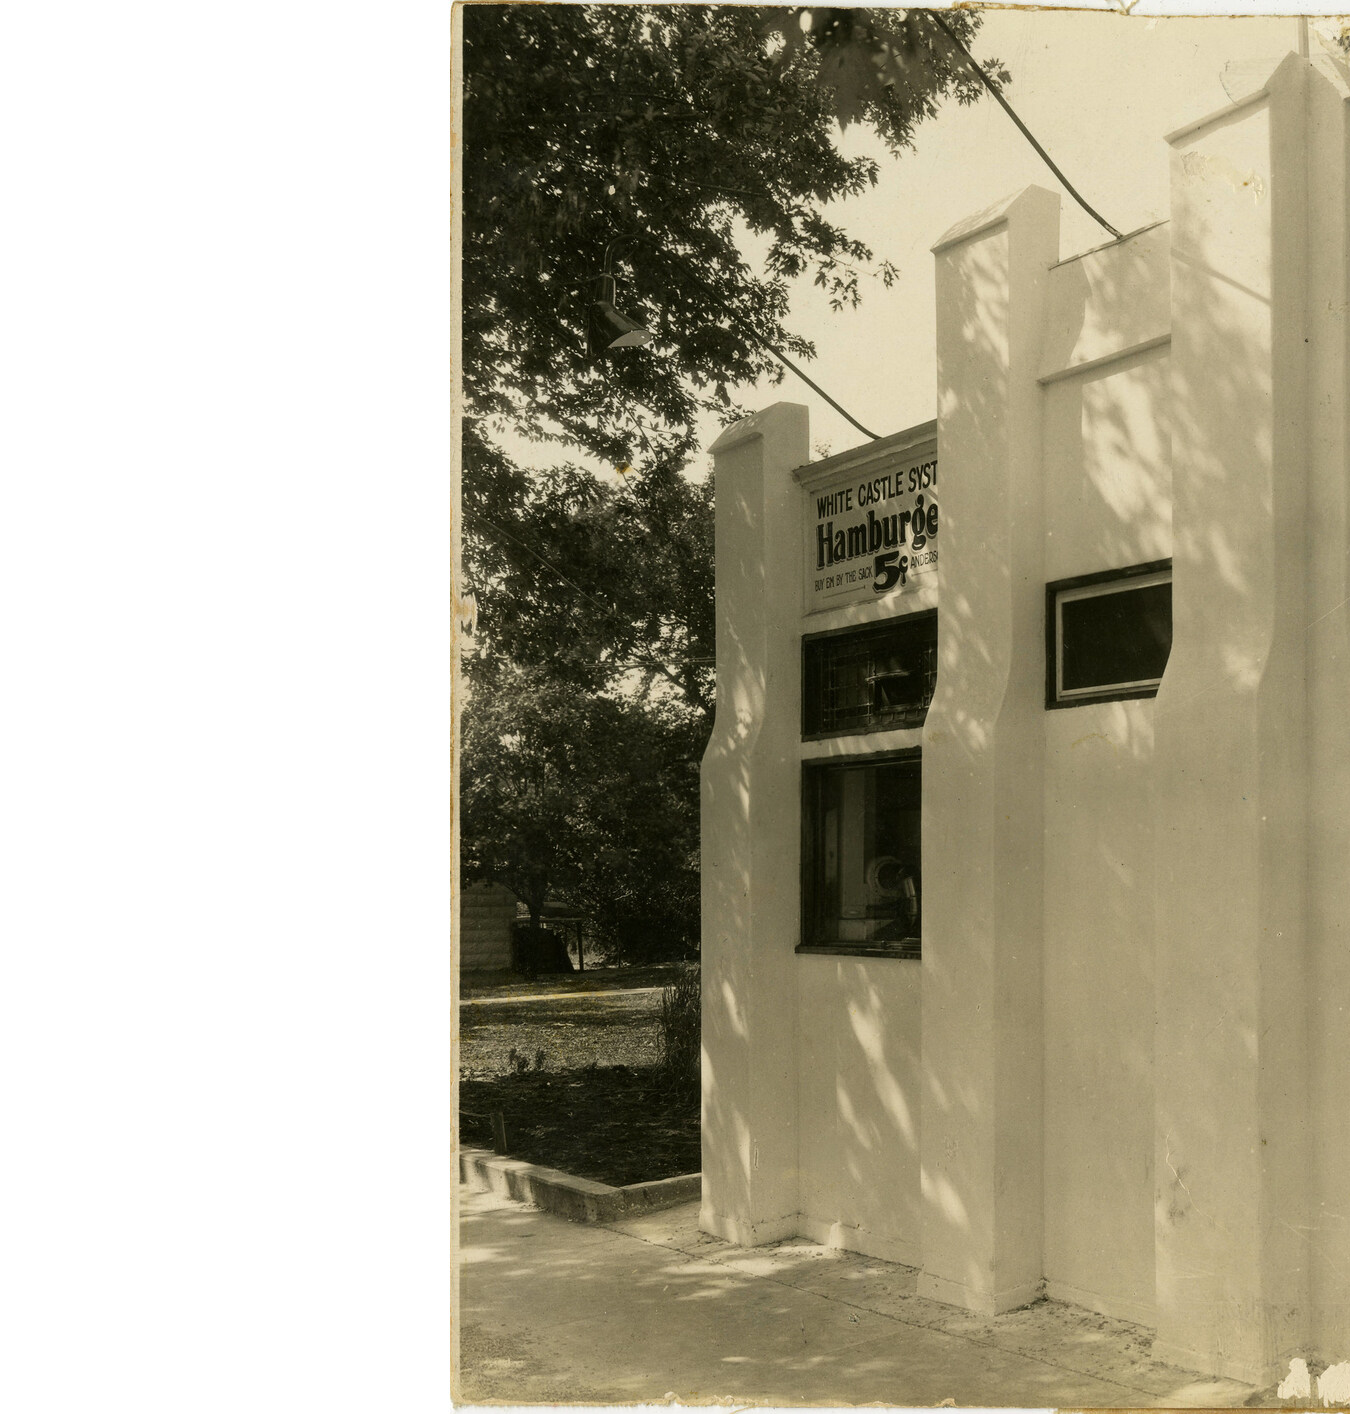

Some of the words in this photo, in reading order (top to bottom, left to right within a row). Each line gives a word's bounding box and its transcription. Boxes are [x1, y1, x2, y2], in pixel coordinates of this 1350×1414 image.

[817, 488, 853, 519] WHITE
[857, 471, 904, 507] CASTLE
[908, 460, 938, 493] SYST
[816, 493, 939, 571] Hamburge
[836, 573, 843, 587] BY
[845, 570, 857, 583] THE
[858, 566, 873, 580] SACK
